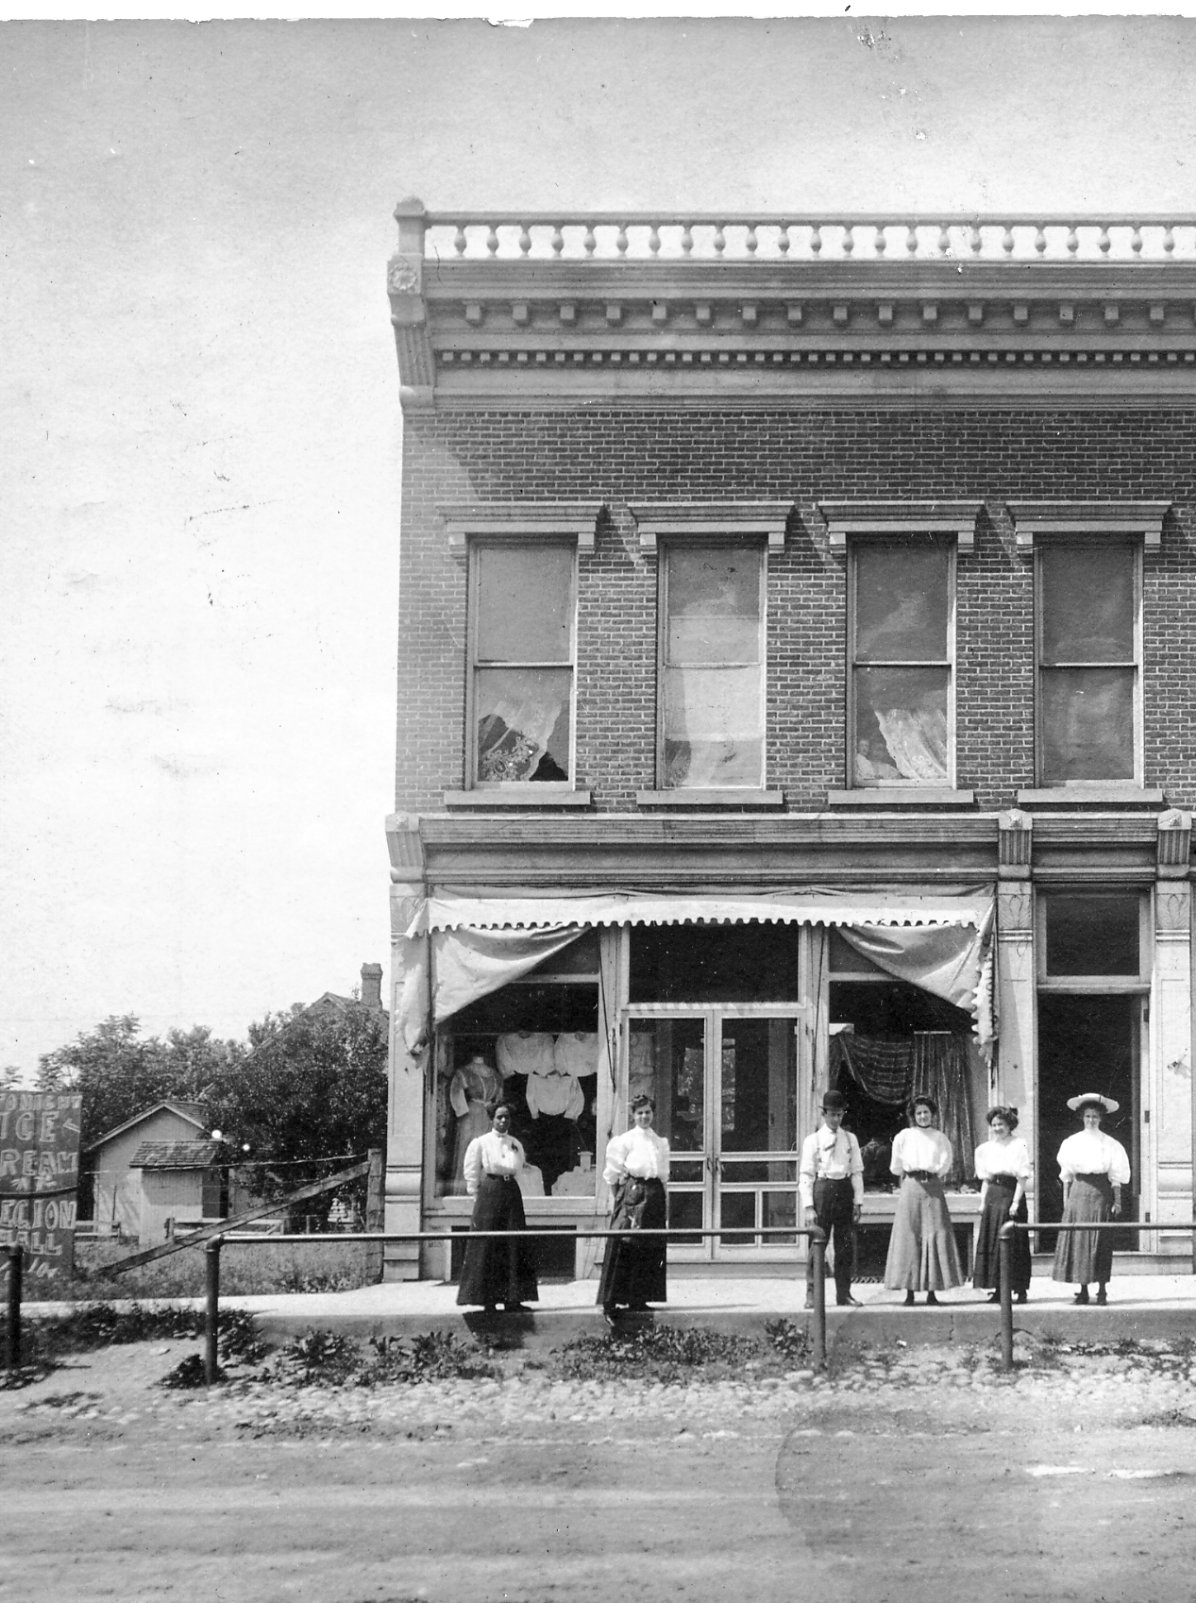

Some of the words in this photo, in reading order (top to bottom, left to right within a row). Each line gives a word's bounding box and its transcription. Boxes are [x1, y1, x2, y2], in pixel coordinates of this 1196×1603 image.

[0, 1111, 60, 1143] ICE
[0, 1149, 79, 1176] REAM
[0, 1199, 77, 1230] EGION
